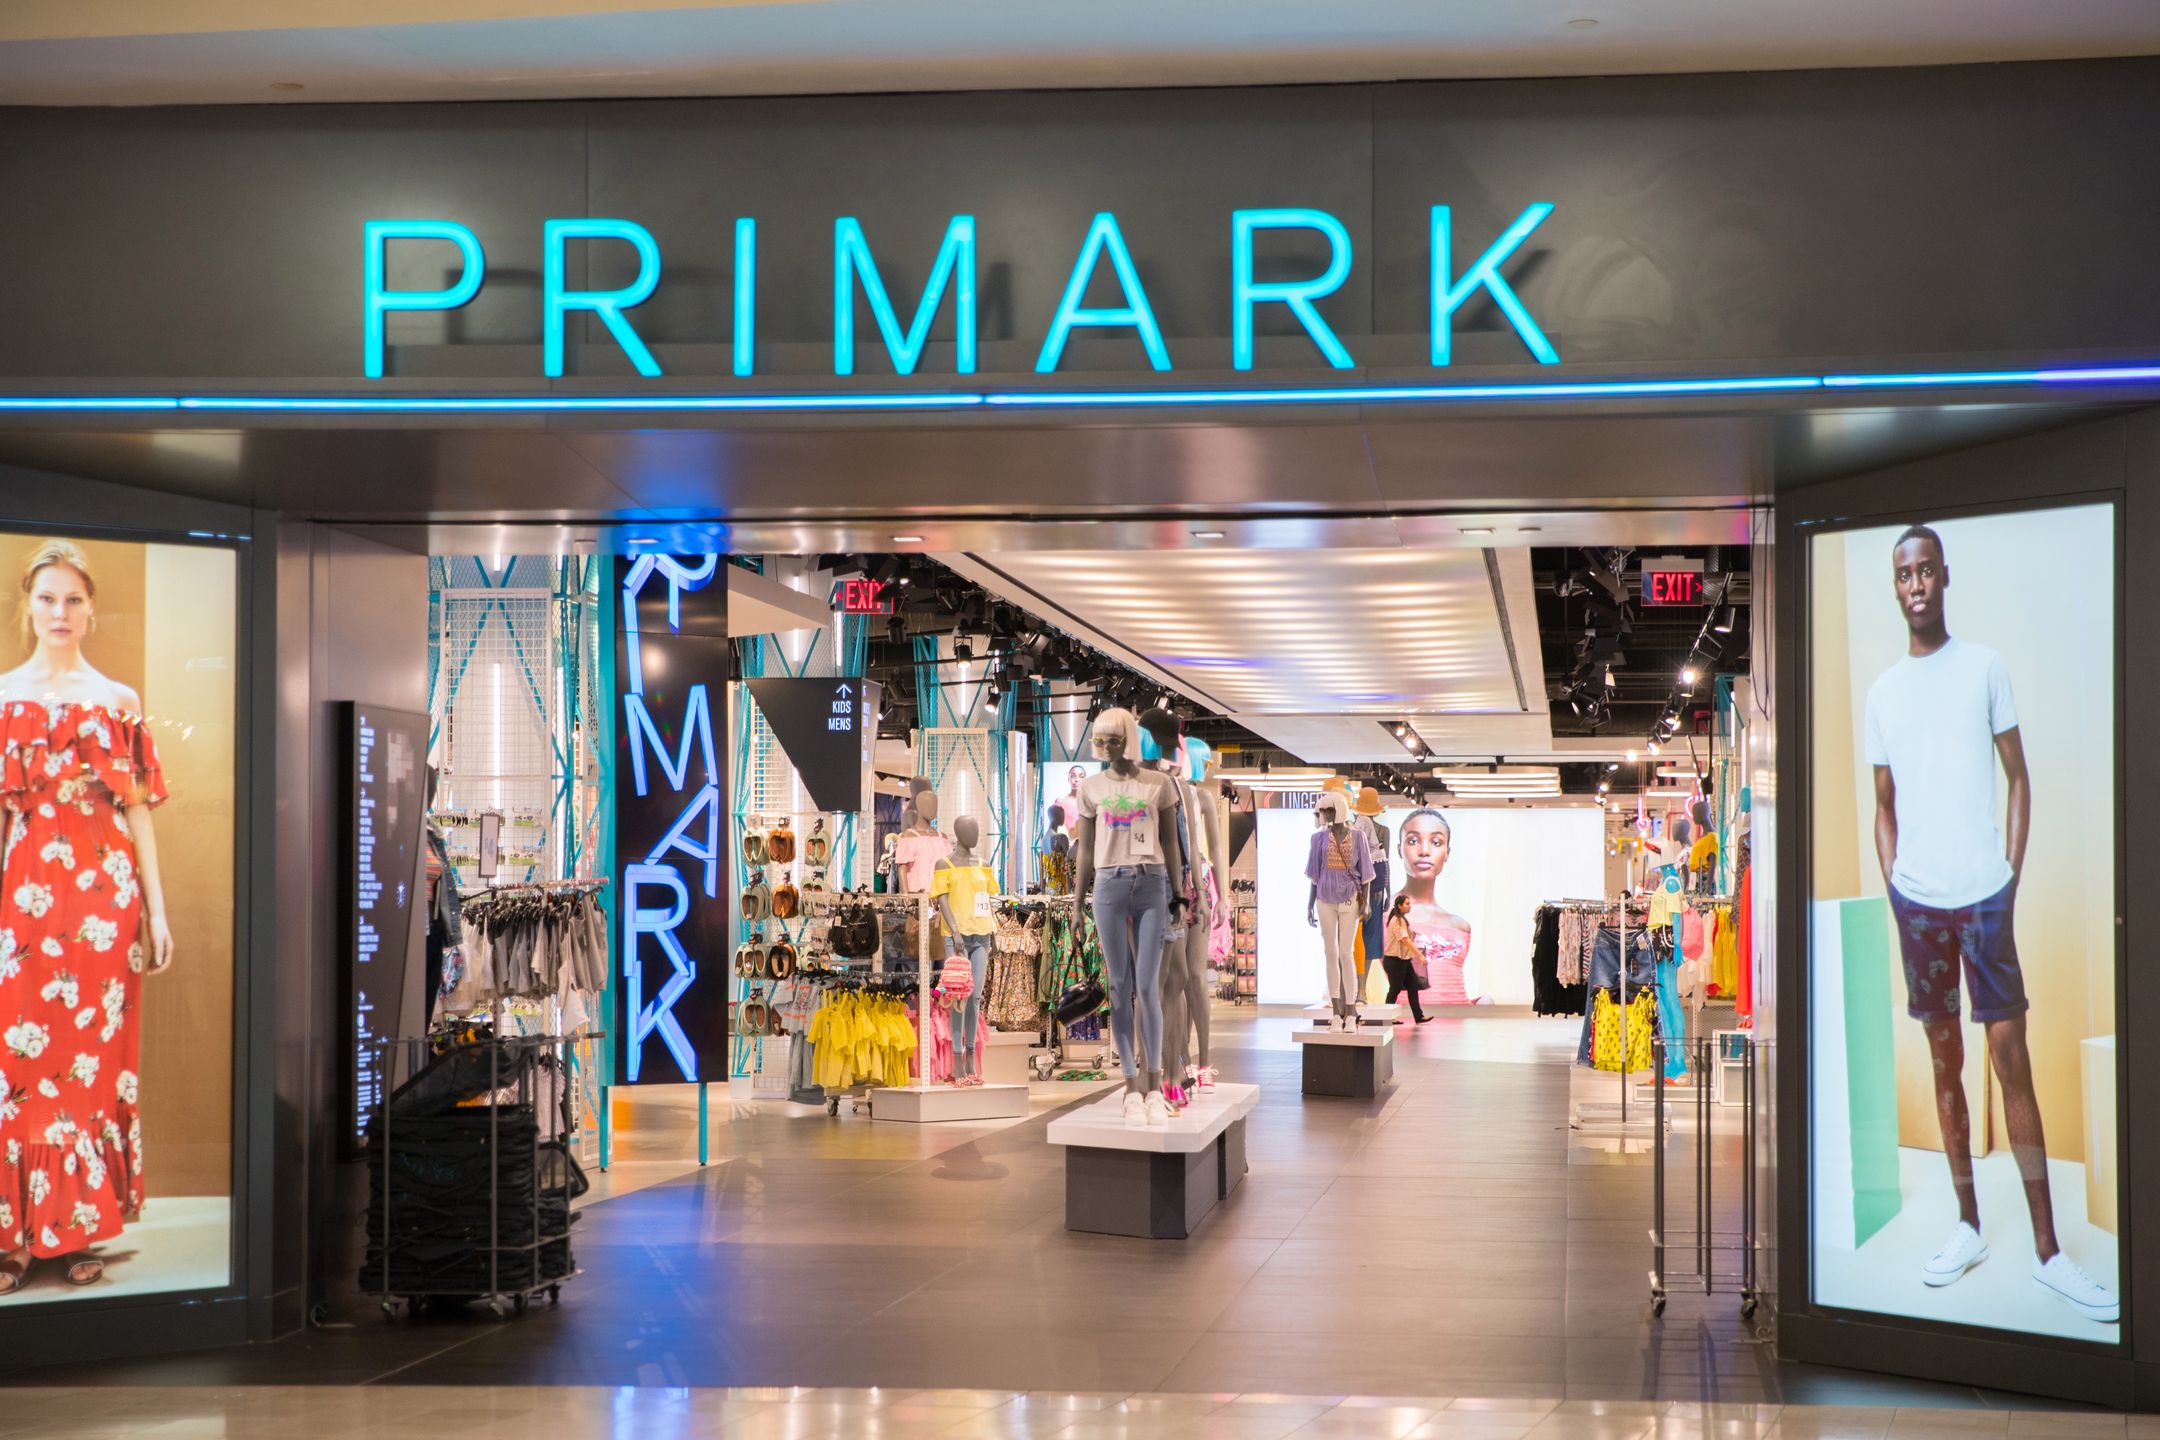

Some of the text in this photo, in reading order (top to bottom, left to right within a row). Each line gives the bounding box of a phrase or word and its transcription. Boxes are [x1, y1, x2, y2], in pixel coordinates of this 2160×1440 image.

[364, 203, 1561, 378] PRIMARK
[1652, 573, 1694, 602] EXIT
[832, 701, 852, 714] KIDS
[828, 718, 852, 731] MENS
[622, 553, 720, 1083] RIMARK
[1134, 832, 1145, 843] $4
